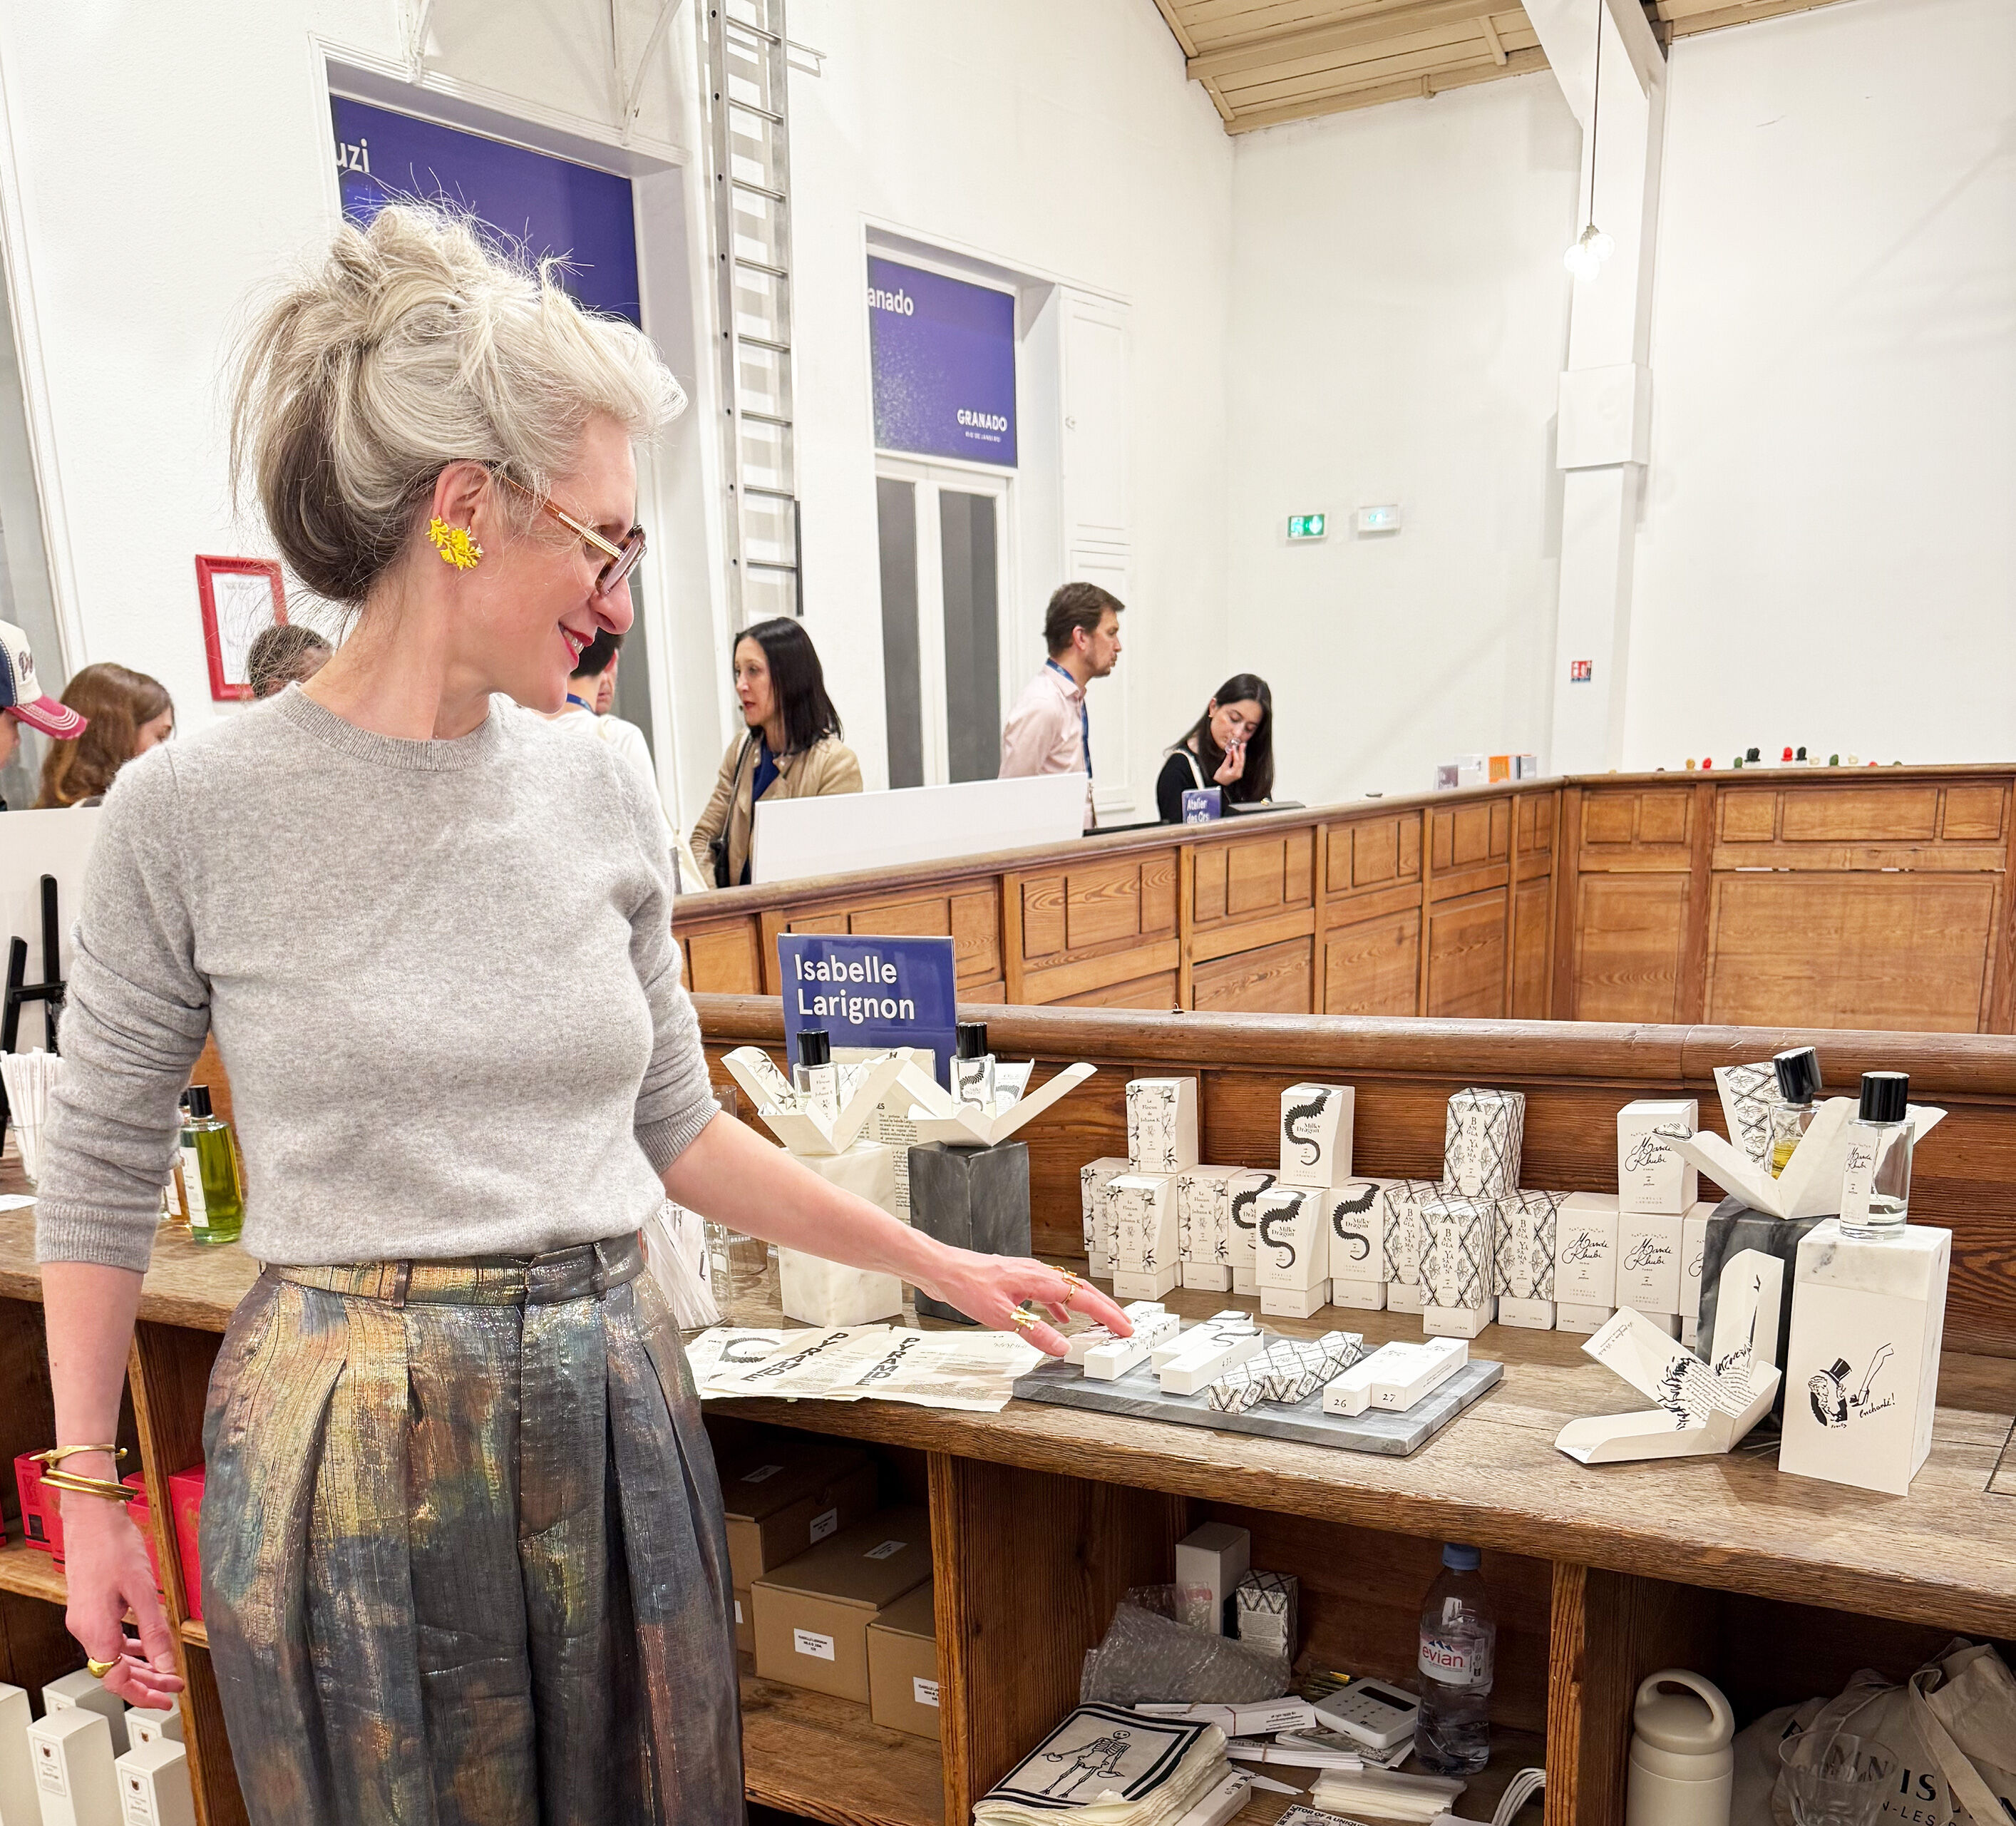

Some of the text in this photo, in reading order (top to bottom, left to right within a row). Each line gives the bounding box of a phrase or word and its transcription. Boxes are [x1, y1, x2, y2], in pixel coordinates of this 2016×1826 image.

[868, 288, 914, 316] anado
[957, 409, 1008, 432] GRANADO
[1186, 796, 1208, 811] Atelier
[1186, 813, 1198, 824] des
[795, 953, 898, 984] Isabelle
[798, 988, 915, 1025] Larignon
[740, 1332, 849, 1382] PYRAMIDE
[855, 1338, 920, 1386] PYRAMIDE
[1334, 1399, 1347, 1407] 26
[1382, 1393, 1396, 1402] 27
[1422, 1646, 1464, 1668] evian
